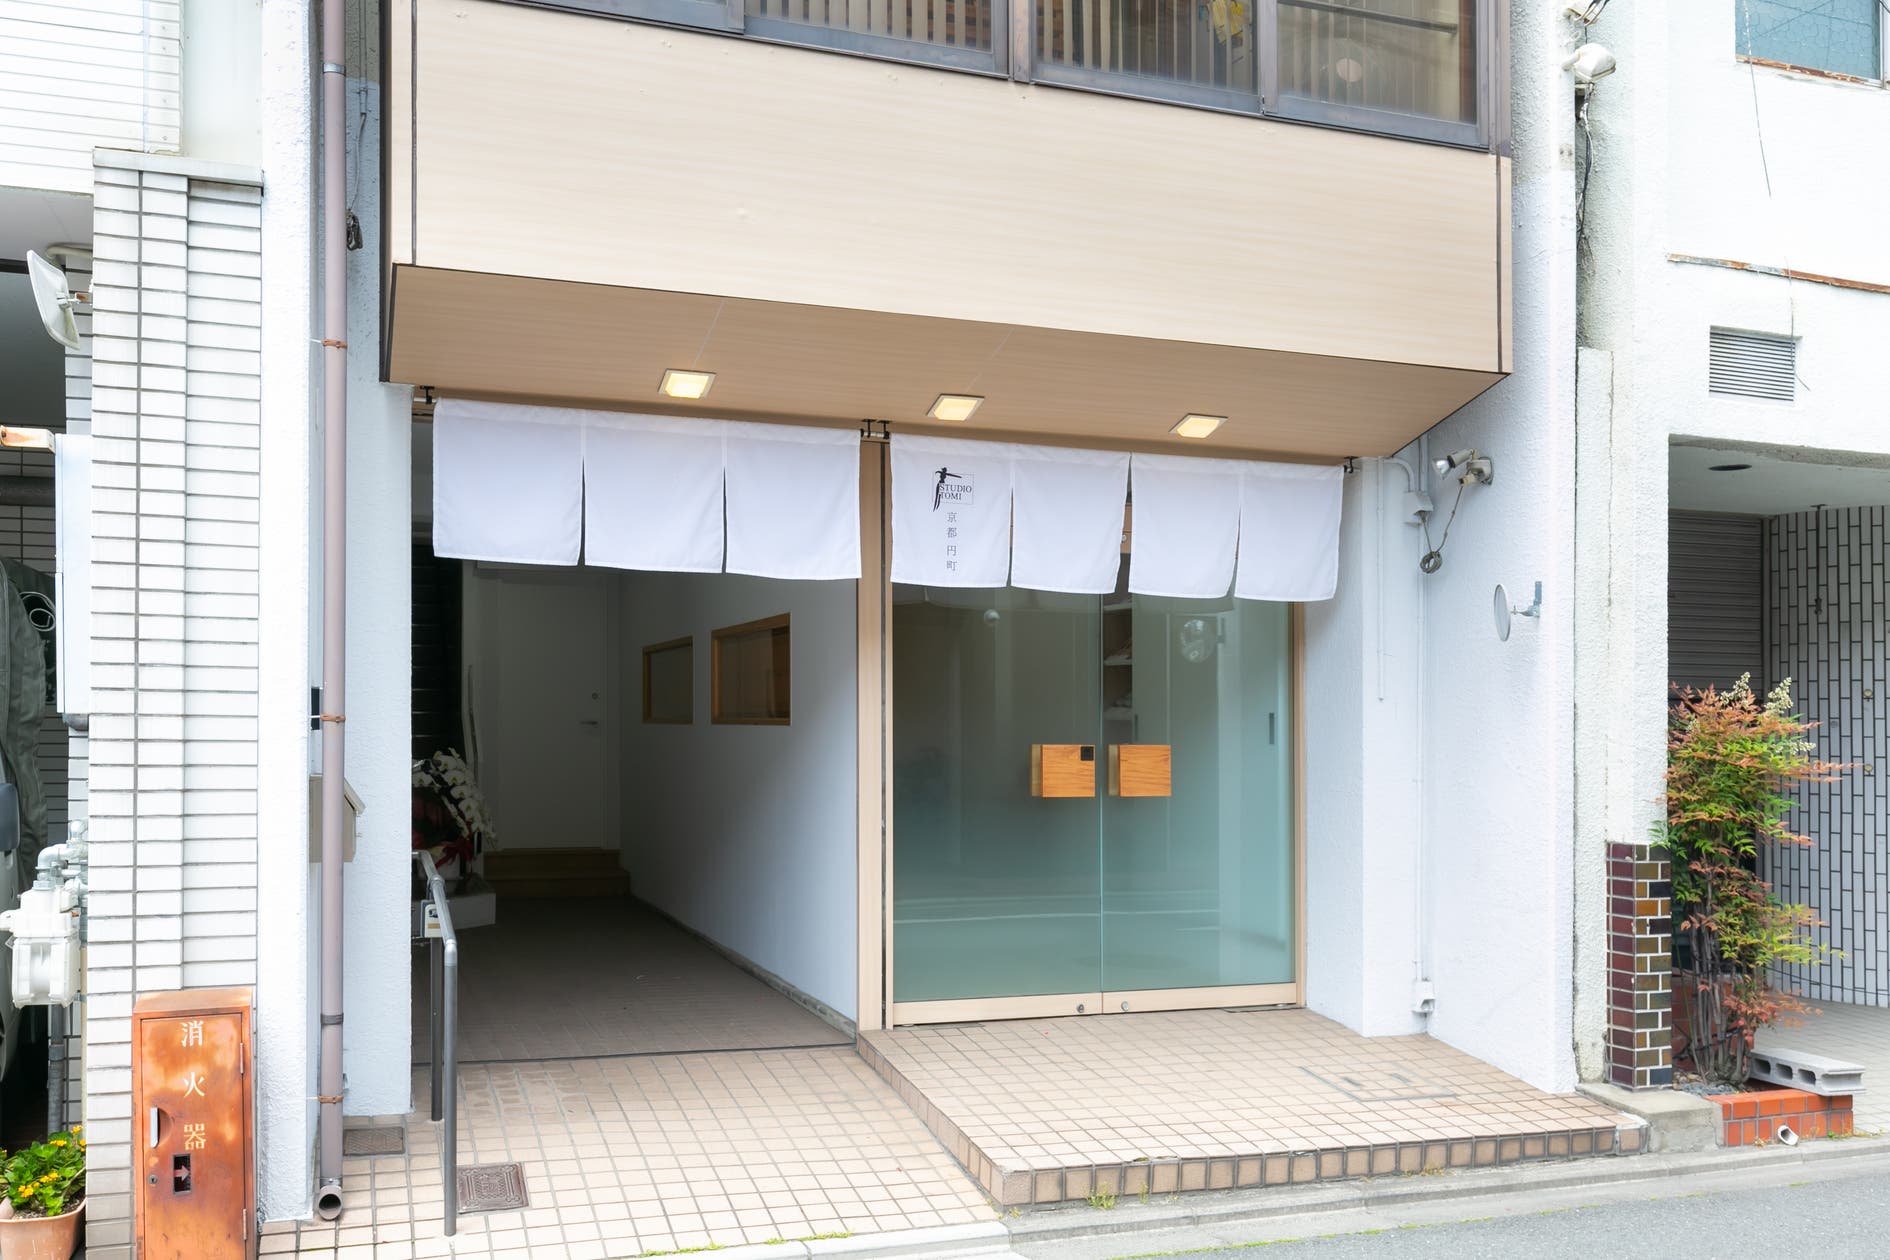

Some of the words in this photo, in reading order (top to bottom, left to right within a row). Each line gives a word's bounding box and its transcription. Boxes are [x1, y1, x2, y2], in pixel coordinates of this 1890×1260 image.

[939, 484, 972, 493] STUDIO
[940, 492, 962, 501] TOMI
[946, 511, 958, 572] 京都円町
[180, 1020, 206, 1150] 消火器
